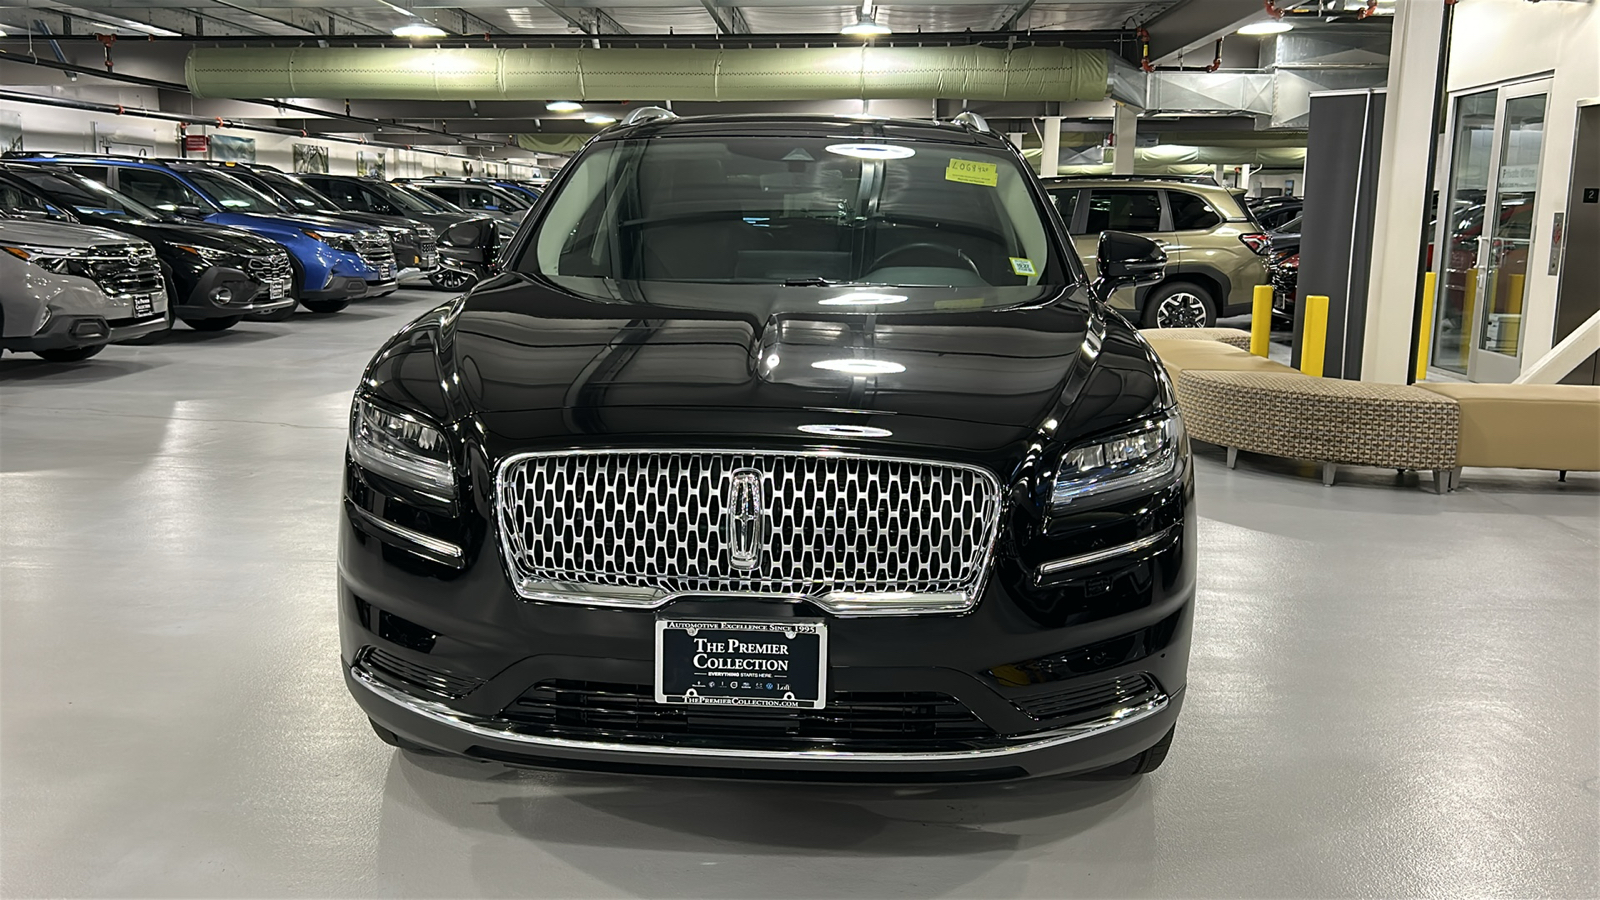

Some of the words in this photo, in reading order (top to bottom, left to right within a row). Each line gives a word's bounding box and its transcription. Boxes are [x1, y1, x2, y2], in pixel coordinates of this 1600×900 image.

[1588, 190, 1595, 199] 2
[668, 621, 719, 629] AUTOMOTIVE
[720, 622, 768, 630] EXCELLENCE
[795, 625, 815, 633] 1995
[693, 638, 725, 653] THE
[727, 639, 789, 655] PREMIER
[693, 653, 789, 671] COLLECTION
